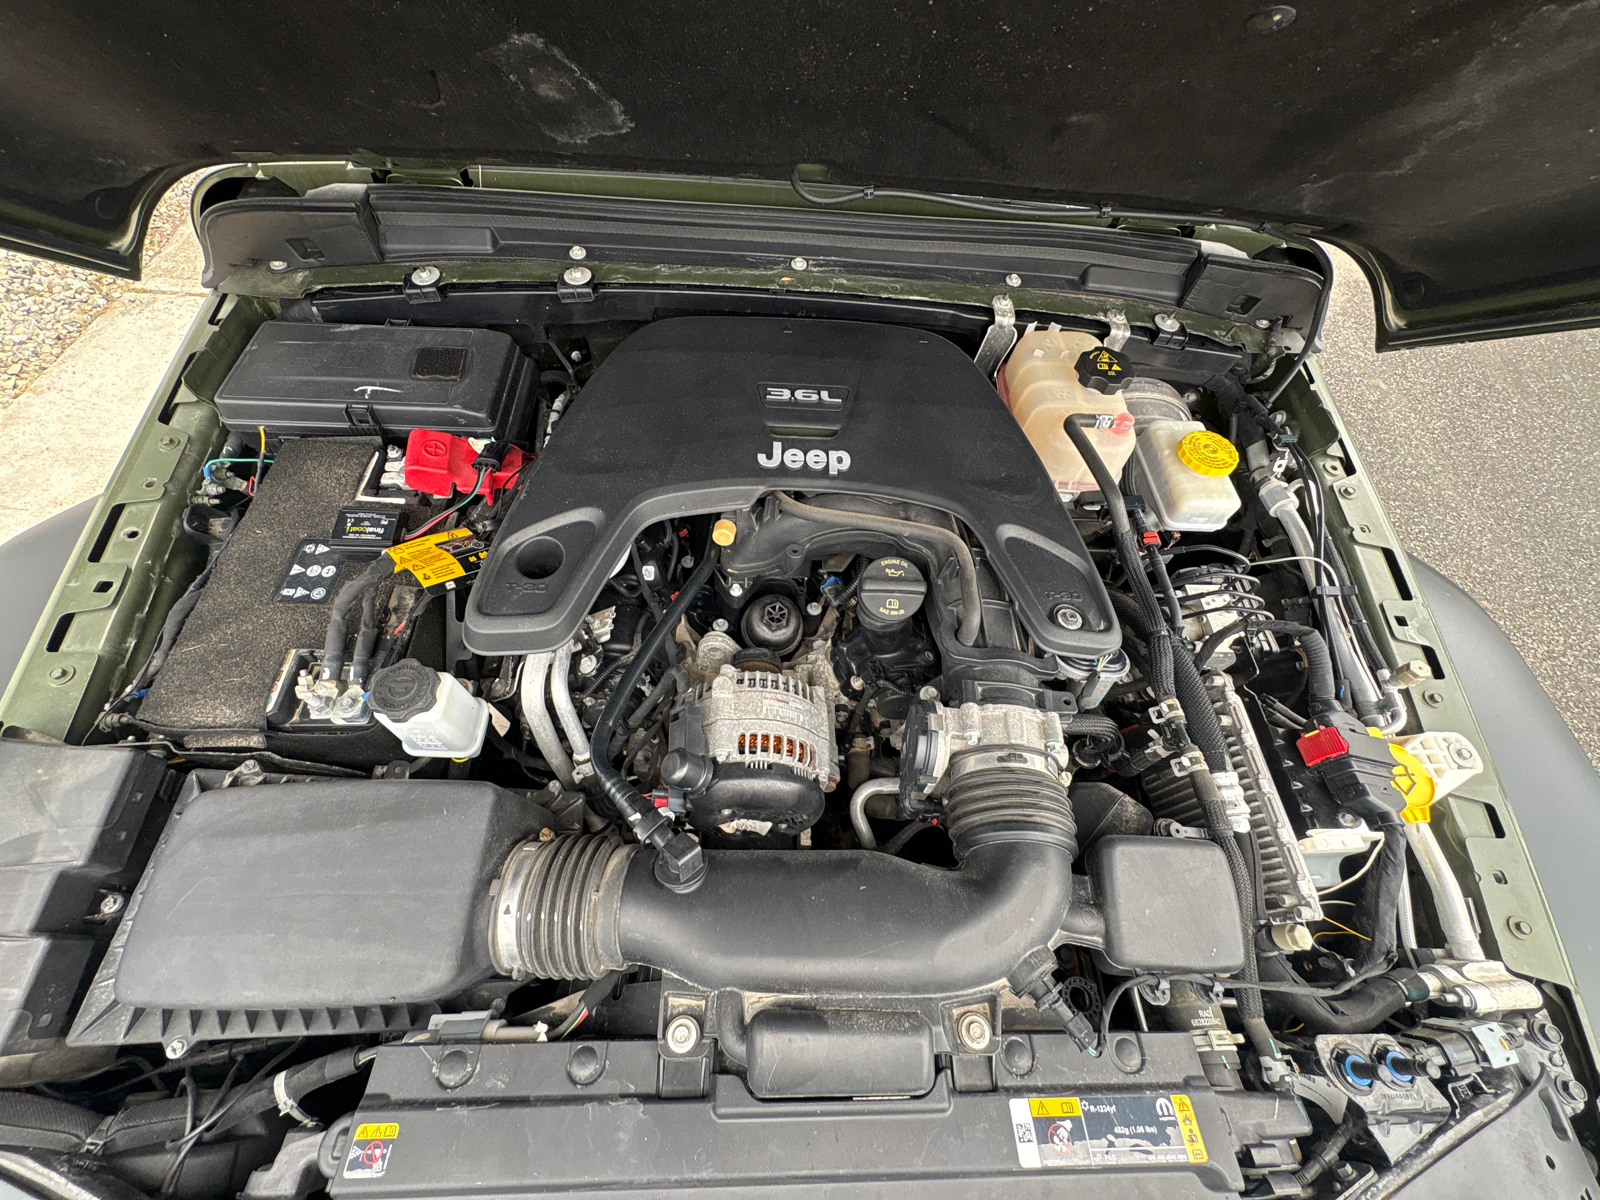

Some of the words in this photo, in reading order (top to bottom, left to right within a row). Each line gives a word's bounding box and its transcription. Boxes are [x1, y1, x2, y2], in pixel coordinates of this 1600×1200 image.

[765, 387, 842, 404] 3.6L
[757, 441, 851, 476] Jeep
[349, 526, 384, 534] finalcoat
[880, 559, 900, 567] ENGINE
[900, 560, 909, 568] OIL
[879, 606, 890, 615] SAE
[1090, 1104, 1117, 1114] R-1234yf
[1145, 1125, 1158, 1134] lbs)
